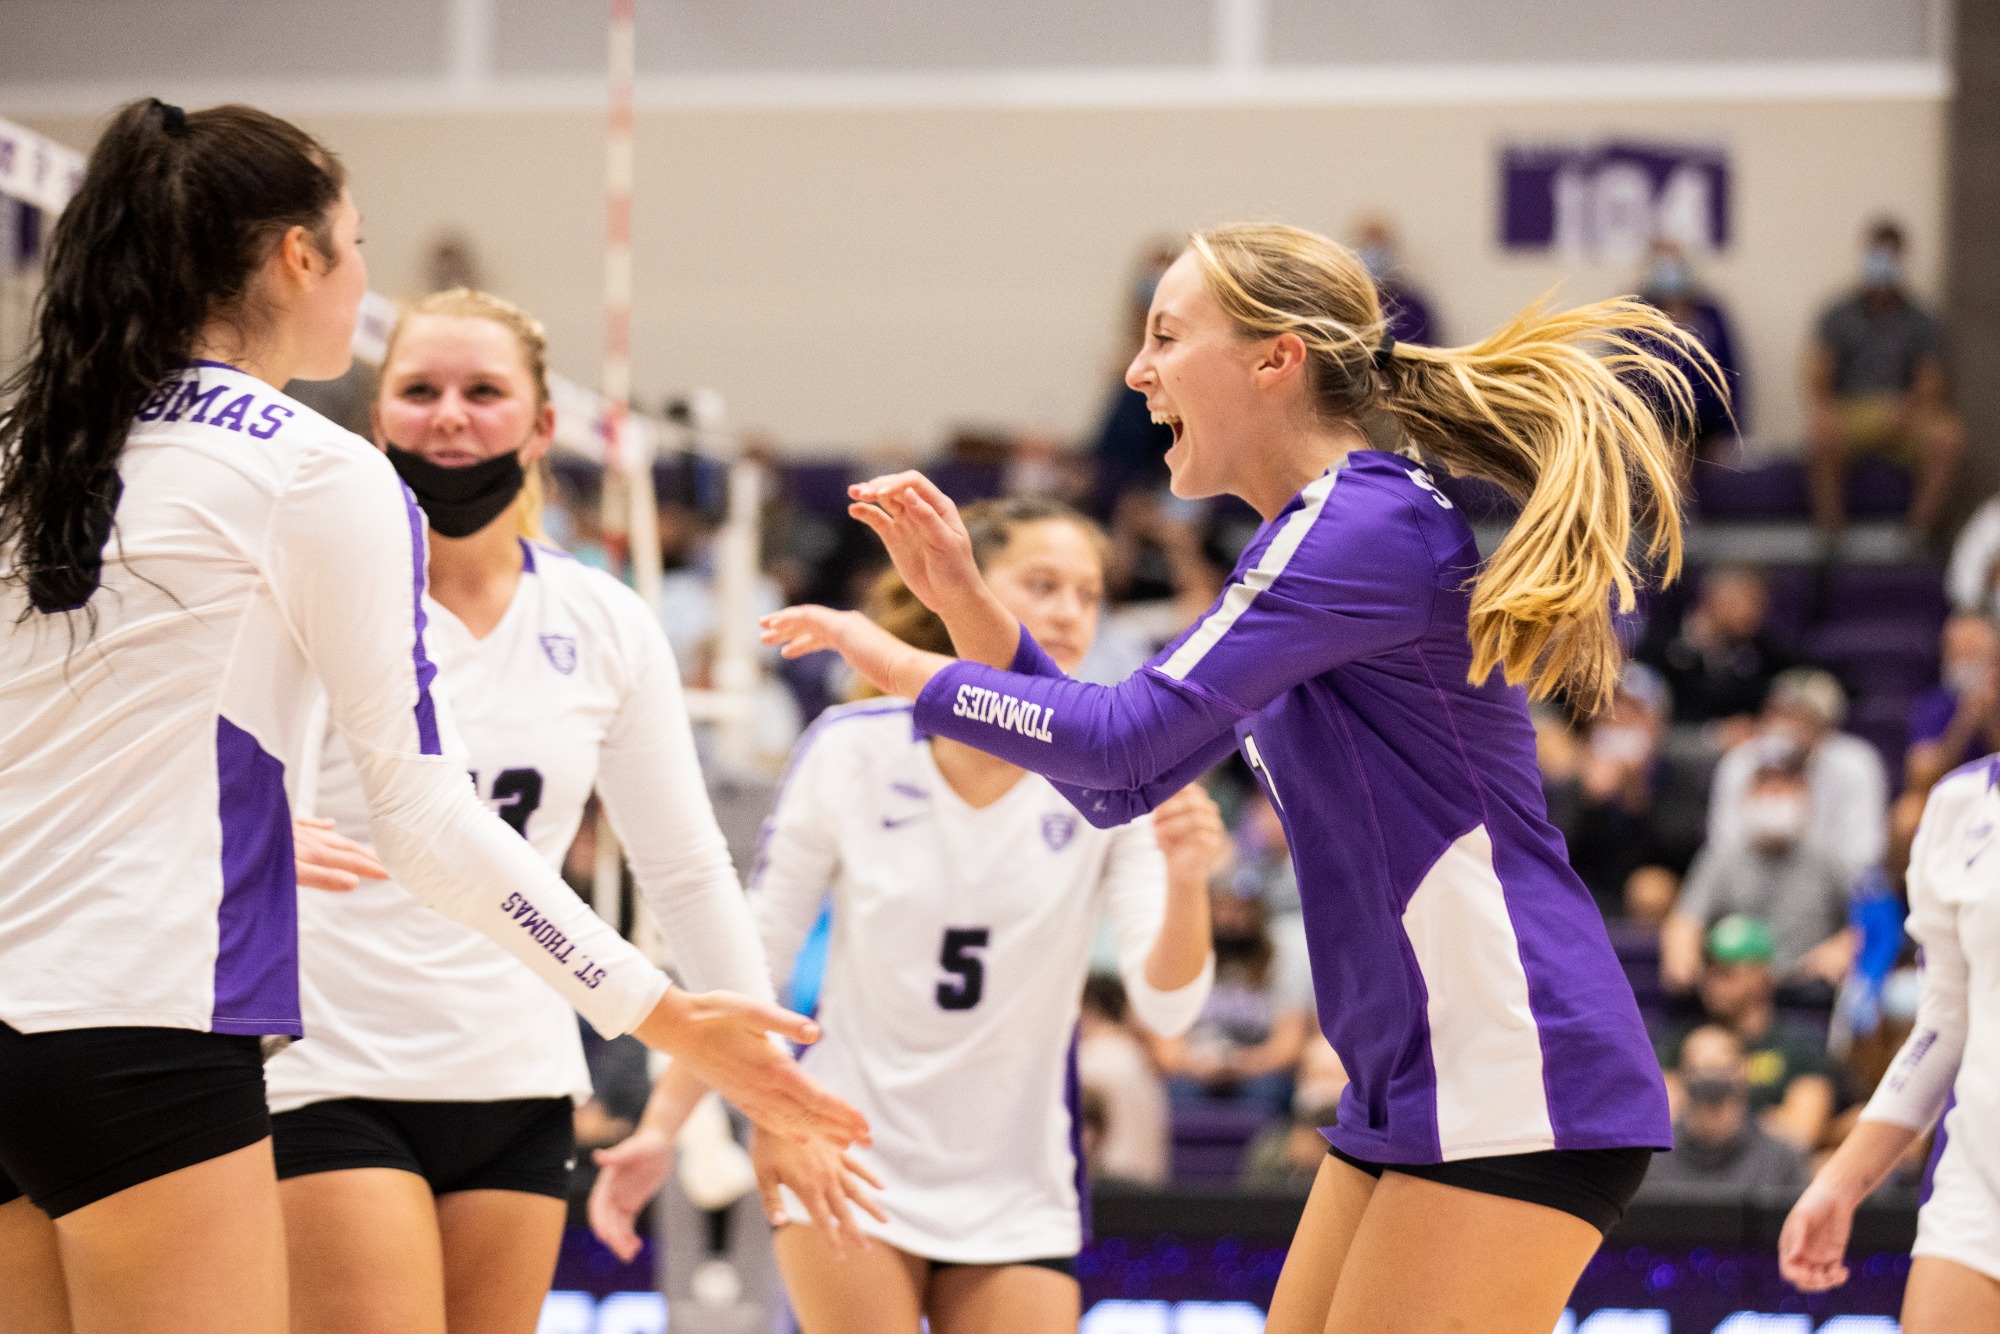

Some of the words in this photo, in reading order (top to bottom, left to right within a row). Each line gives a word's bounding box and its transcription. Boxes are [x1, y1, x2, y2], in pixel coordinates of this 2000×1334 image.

[952, 683, 1055, 743] TOMMIES
[500, 891, 576, 965] THOMAS
[935, 927, 990, 1011] 5
